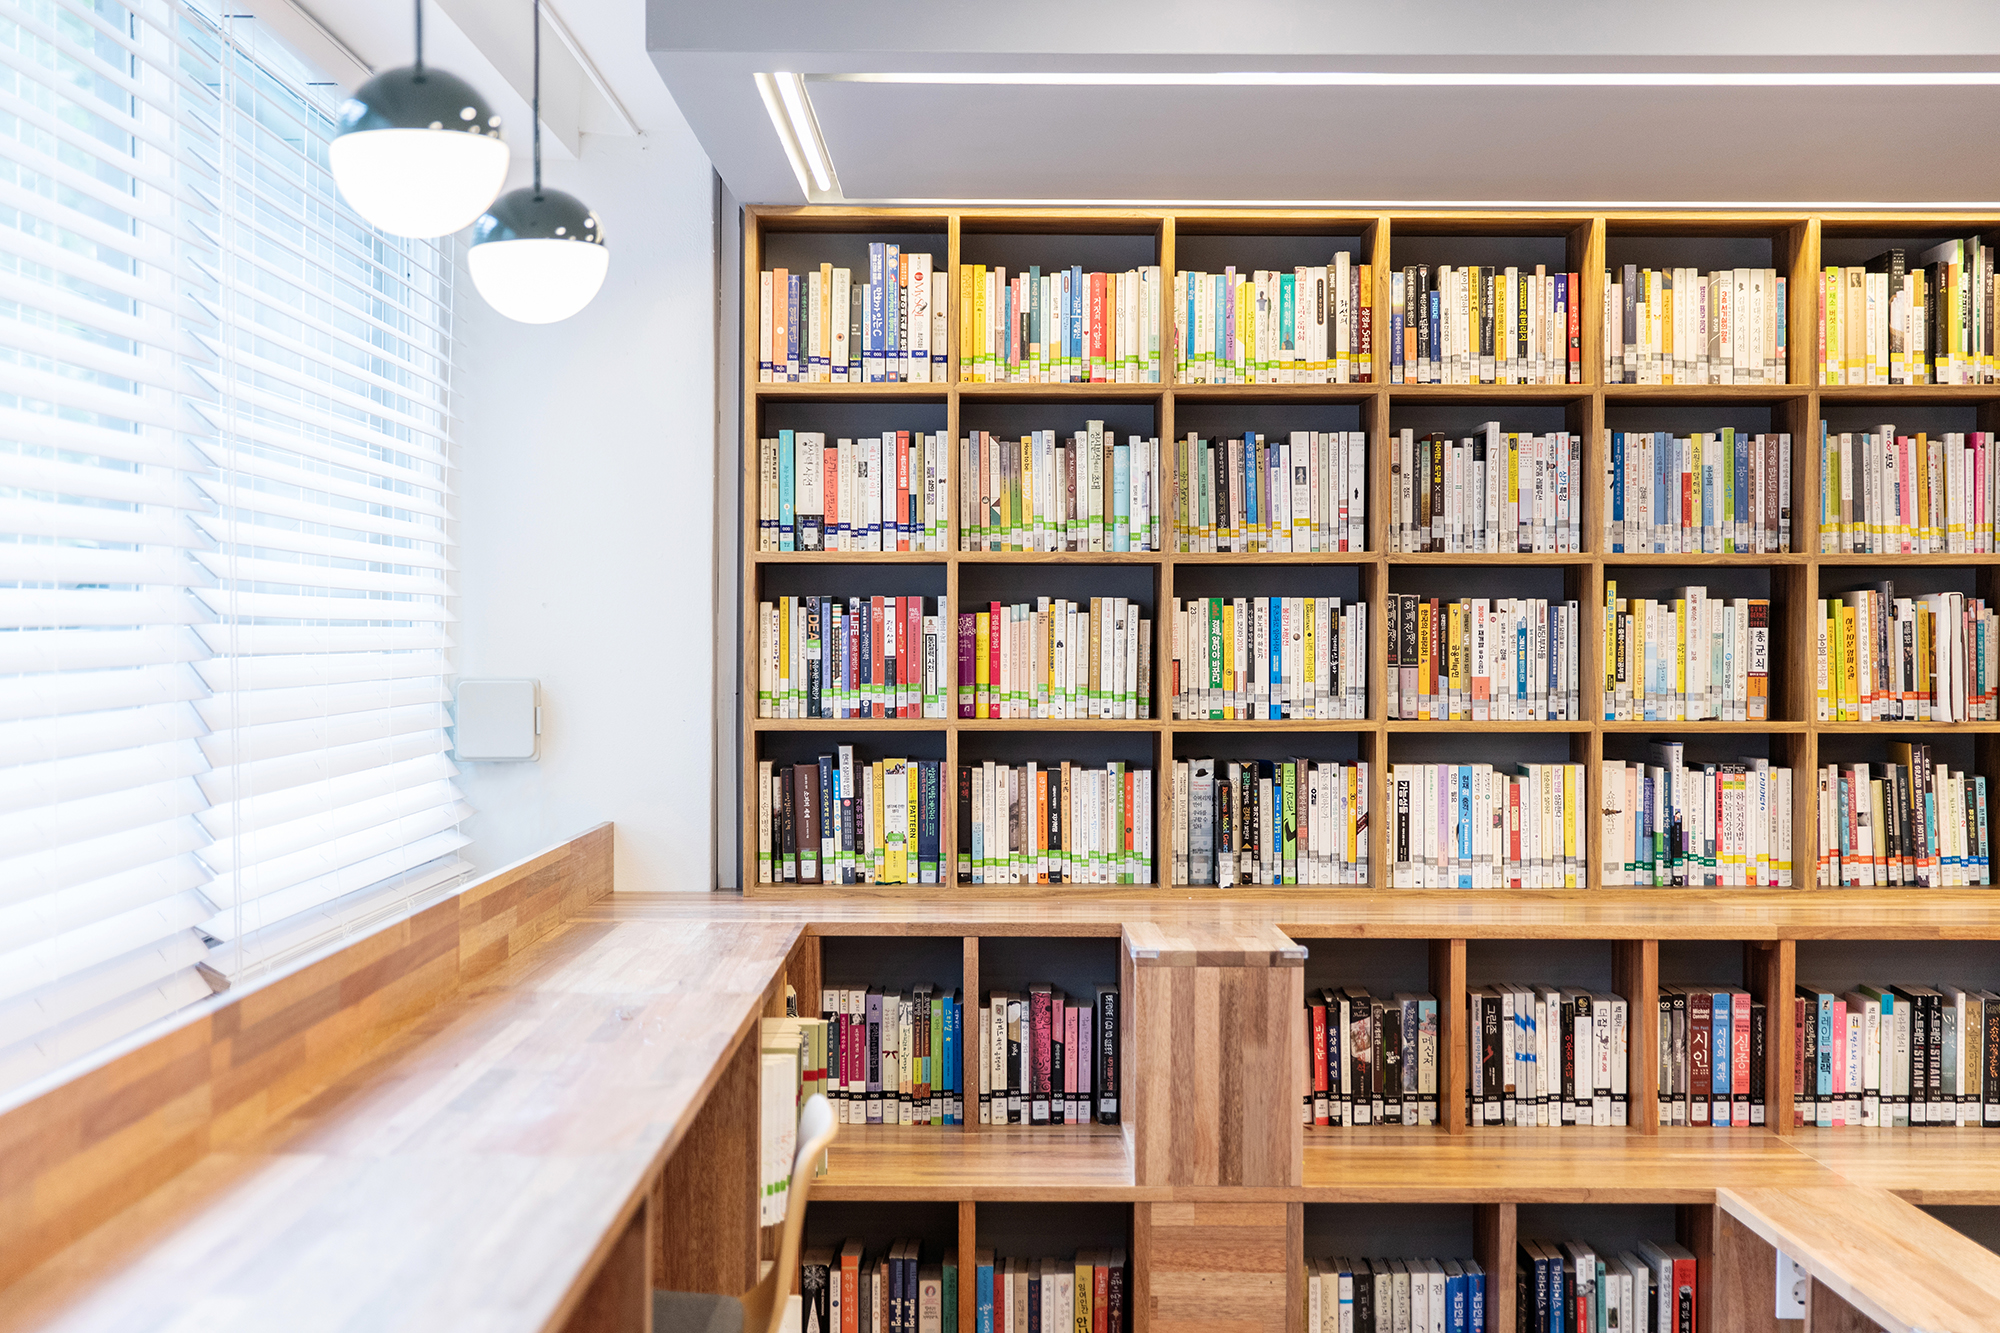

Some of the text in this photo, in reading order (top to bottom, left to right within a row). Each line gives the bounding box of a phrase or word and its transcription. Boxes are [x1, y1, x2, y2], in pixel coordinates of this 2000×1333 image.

[912, 282, 924, 321] MySQL
[1559, 470, 1567, 501] 상가 특강
[1190, 607, 1196, 615] 23
[1818, 634, 1826, 656] 아이의
[1399, 782, 1408, 814] 가능성들
[1693, 1032, 1708, 1068] 시인
[1914, 1011, 1924, 1088] 스트레인 STRAIN
[1930, 1010, 1941, 1087] 스트레인 STRAIN
[1538, 1265, 1548, 1309] 파라다이스
[1551, 1266, 1561, 1309] 파라다이스
[1454, 1292, 1463, 1327] 제3인류
[1473, 1292, 1483, 1327] 제3인류
